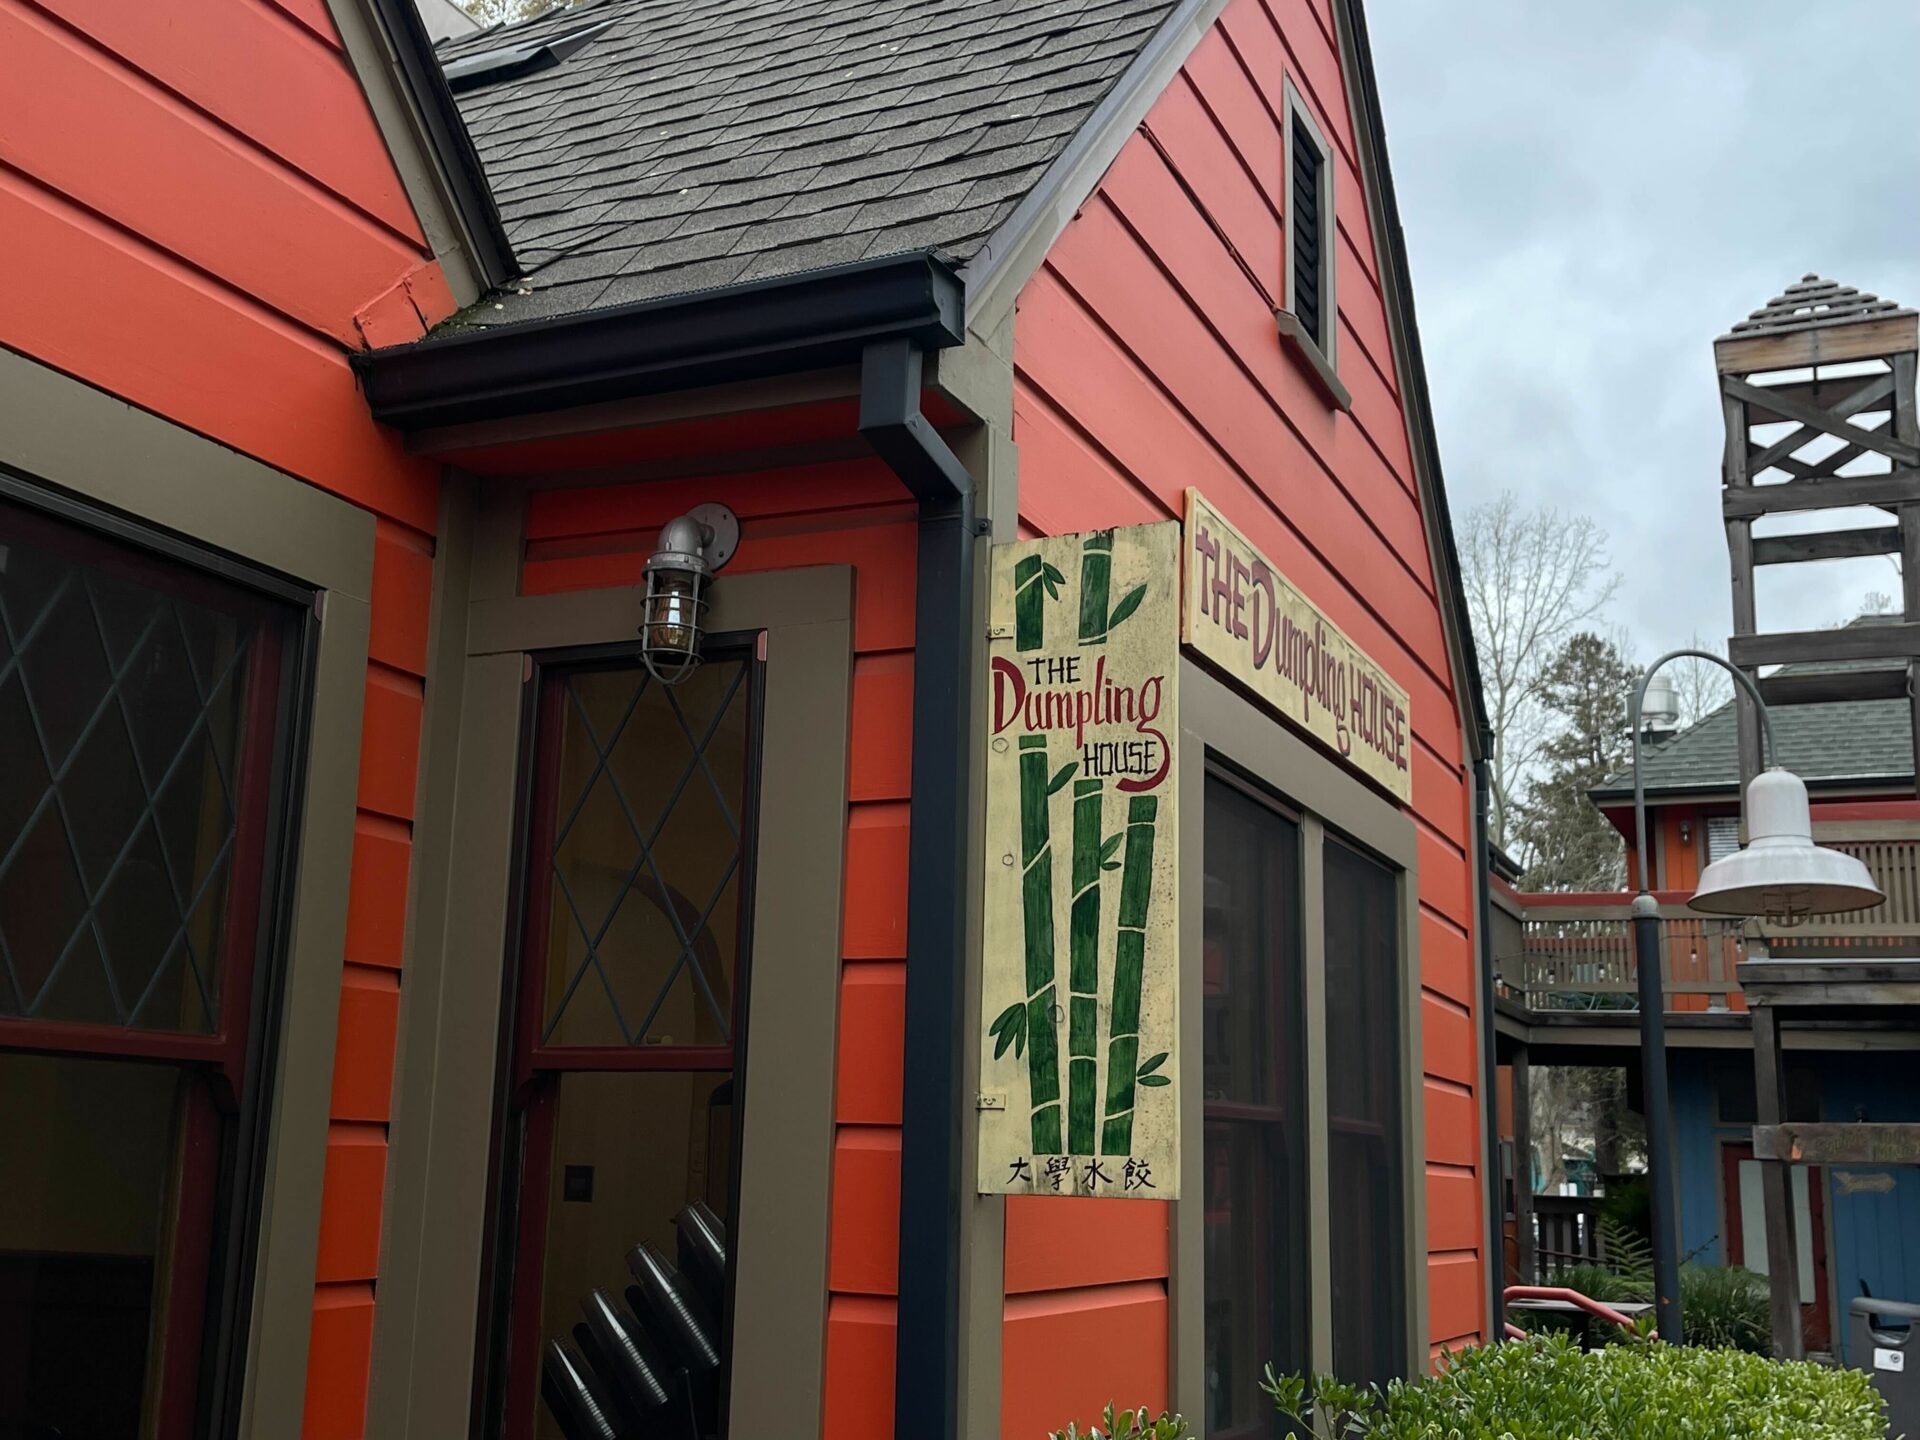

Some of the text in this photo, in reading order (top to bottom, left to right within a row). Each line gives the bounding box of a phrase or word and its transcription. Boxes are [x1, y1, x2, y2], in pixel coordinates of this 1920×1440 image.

[1027, 656, 1081, 685] THE
[1251, 559, 1351, 758] Dumpling
[1349, 663, 1408, 772] HOUSE
[991, 655, 1171, 792] Dumpling
[1083, 741, 1158, 777] HOUSE
[1006, 1156, 1157, 1192] 大學水餃
